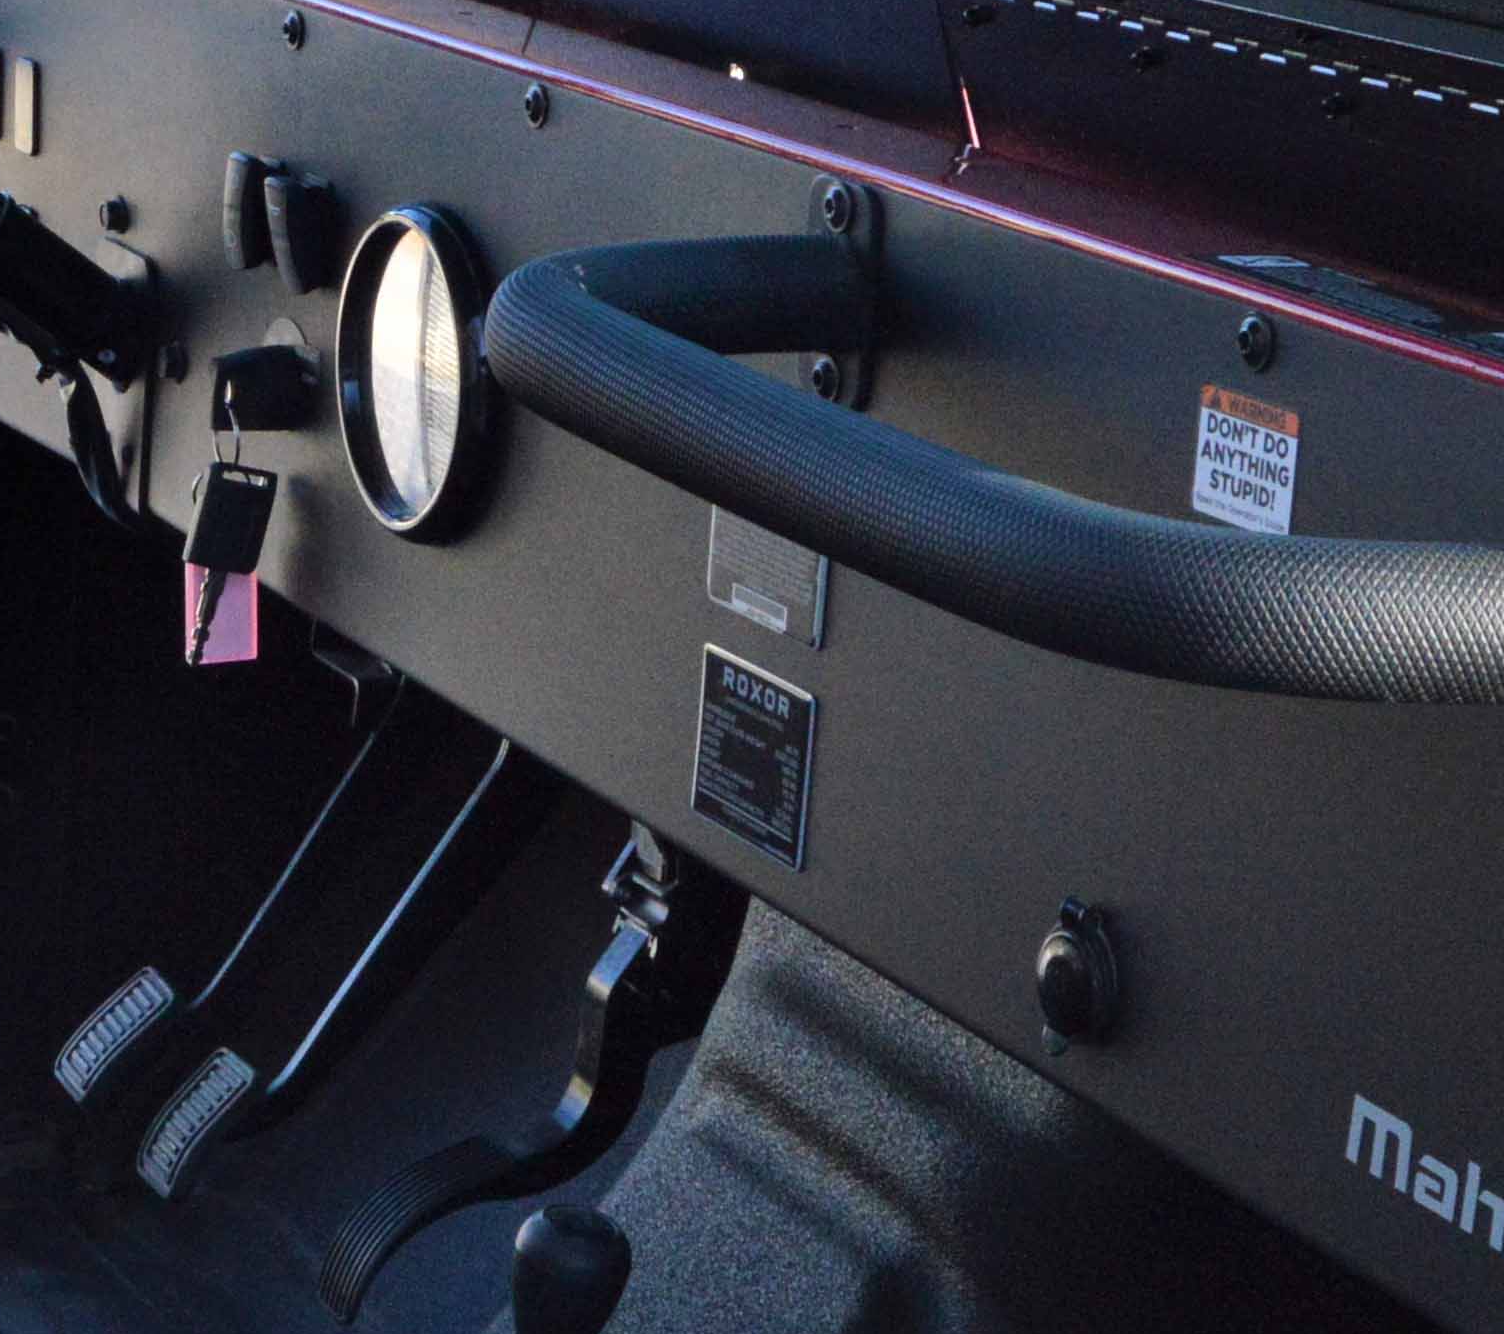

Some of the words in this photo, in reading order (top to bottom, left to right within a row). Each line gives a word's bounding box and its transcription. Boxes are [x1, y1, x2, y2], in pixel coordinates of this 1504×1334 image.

[1207, 413, 1259, 449] DON'T
[1263, 436, 1289, 459] DO
[1201, 438, 1289, 488] ANYTHING
[1209, 468, 1276, 511] STUPID!
[722, 665, 791, 719] ROXOR
